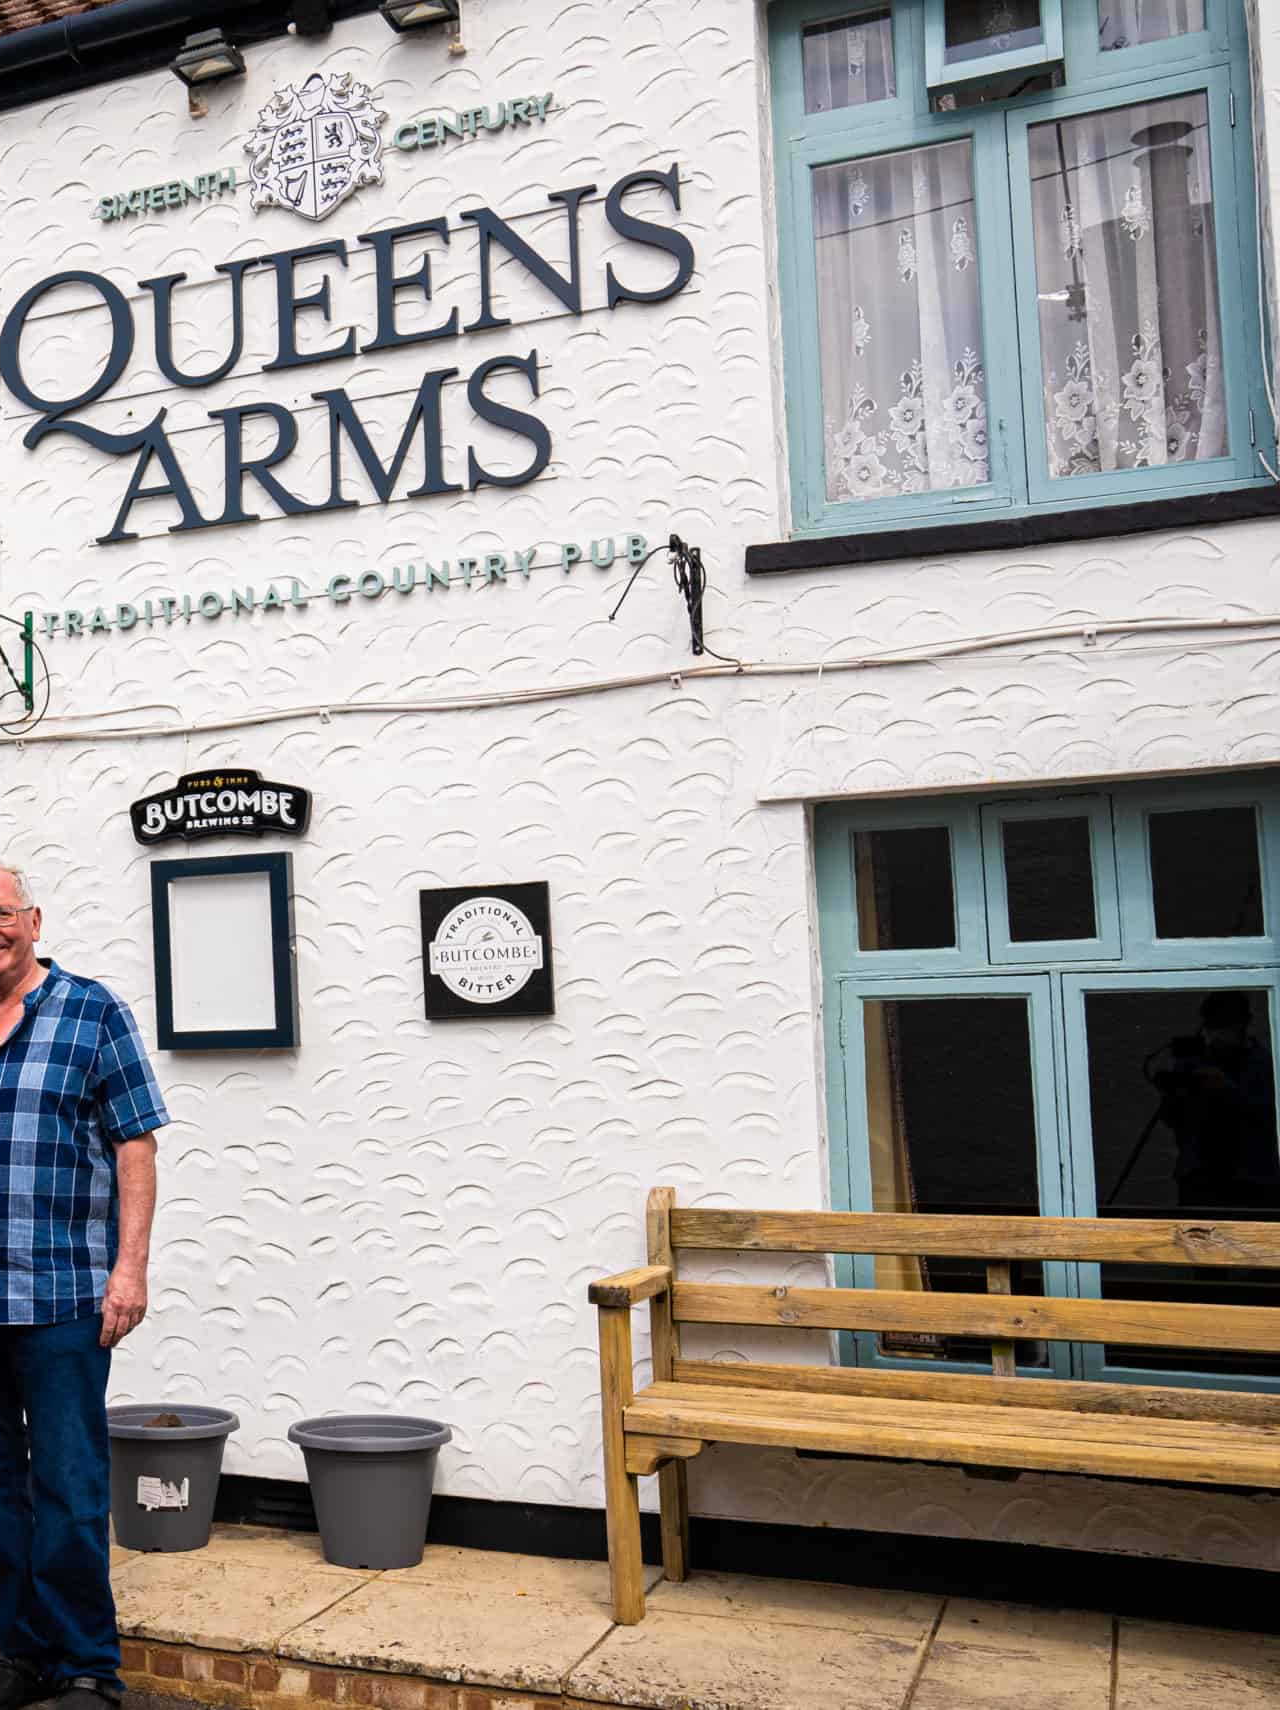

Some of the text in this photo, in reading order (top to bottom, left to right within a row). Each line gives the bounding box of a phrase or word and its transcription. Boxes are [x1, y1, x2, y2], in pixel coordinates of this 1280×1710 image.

[97, 92, 554, 222] SIXTEENTH CENTURY
[95, 349, 553, 545] ARMS
[41, 534, 649, 639] TRADITIONAL COUNTRY PUB
[141, 790, 296, 835] BUTCOMBE
[186, 815, 240, 830] BREWING
[446, 906, 524, 941] TRADITIONAL
[440, 945, 532, 964] BUTCOMBE
[458, 974, 516, 994] BITTER
